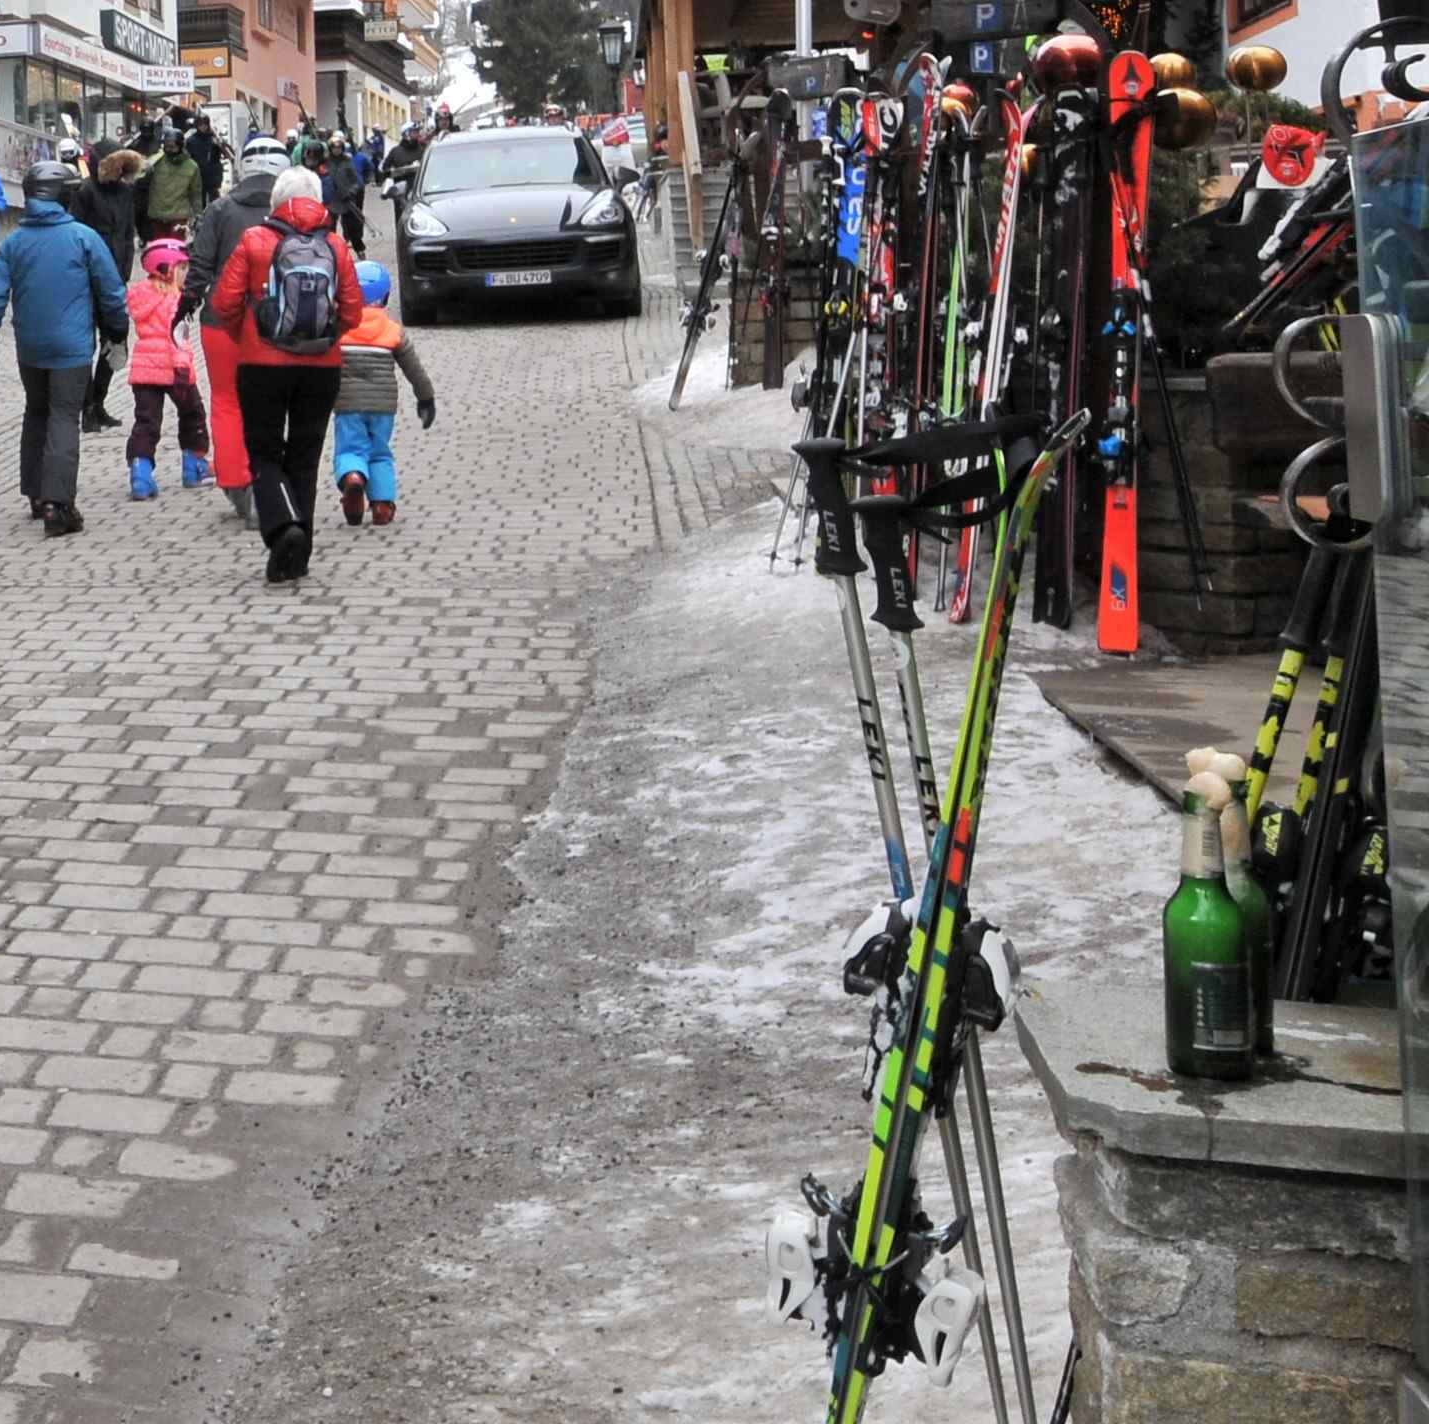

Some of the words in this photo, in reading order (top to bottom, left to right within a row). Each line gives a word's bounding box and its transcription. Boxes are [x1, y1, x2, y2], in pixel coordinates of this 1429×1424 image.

[976, 3, 994, 29] P
[974, 44, 988, 68] P
[146, 69, 164, 79] SKI
[167, 69, 189, 80] PRO
[889, 566, 909, 609] LEKI
[856, 695, 887, 783] LEKI
